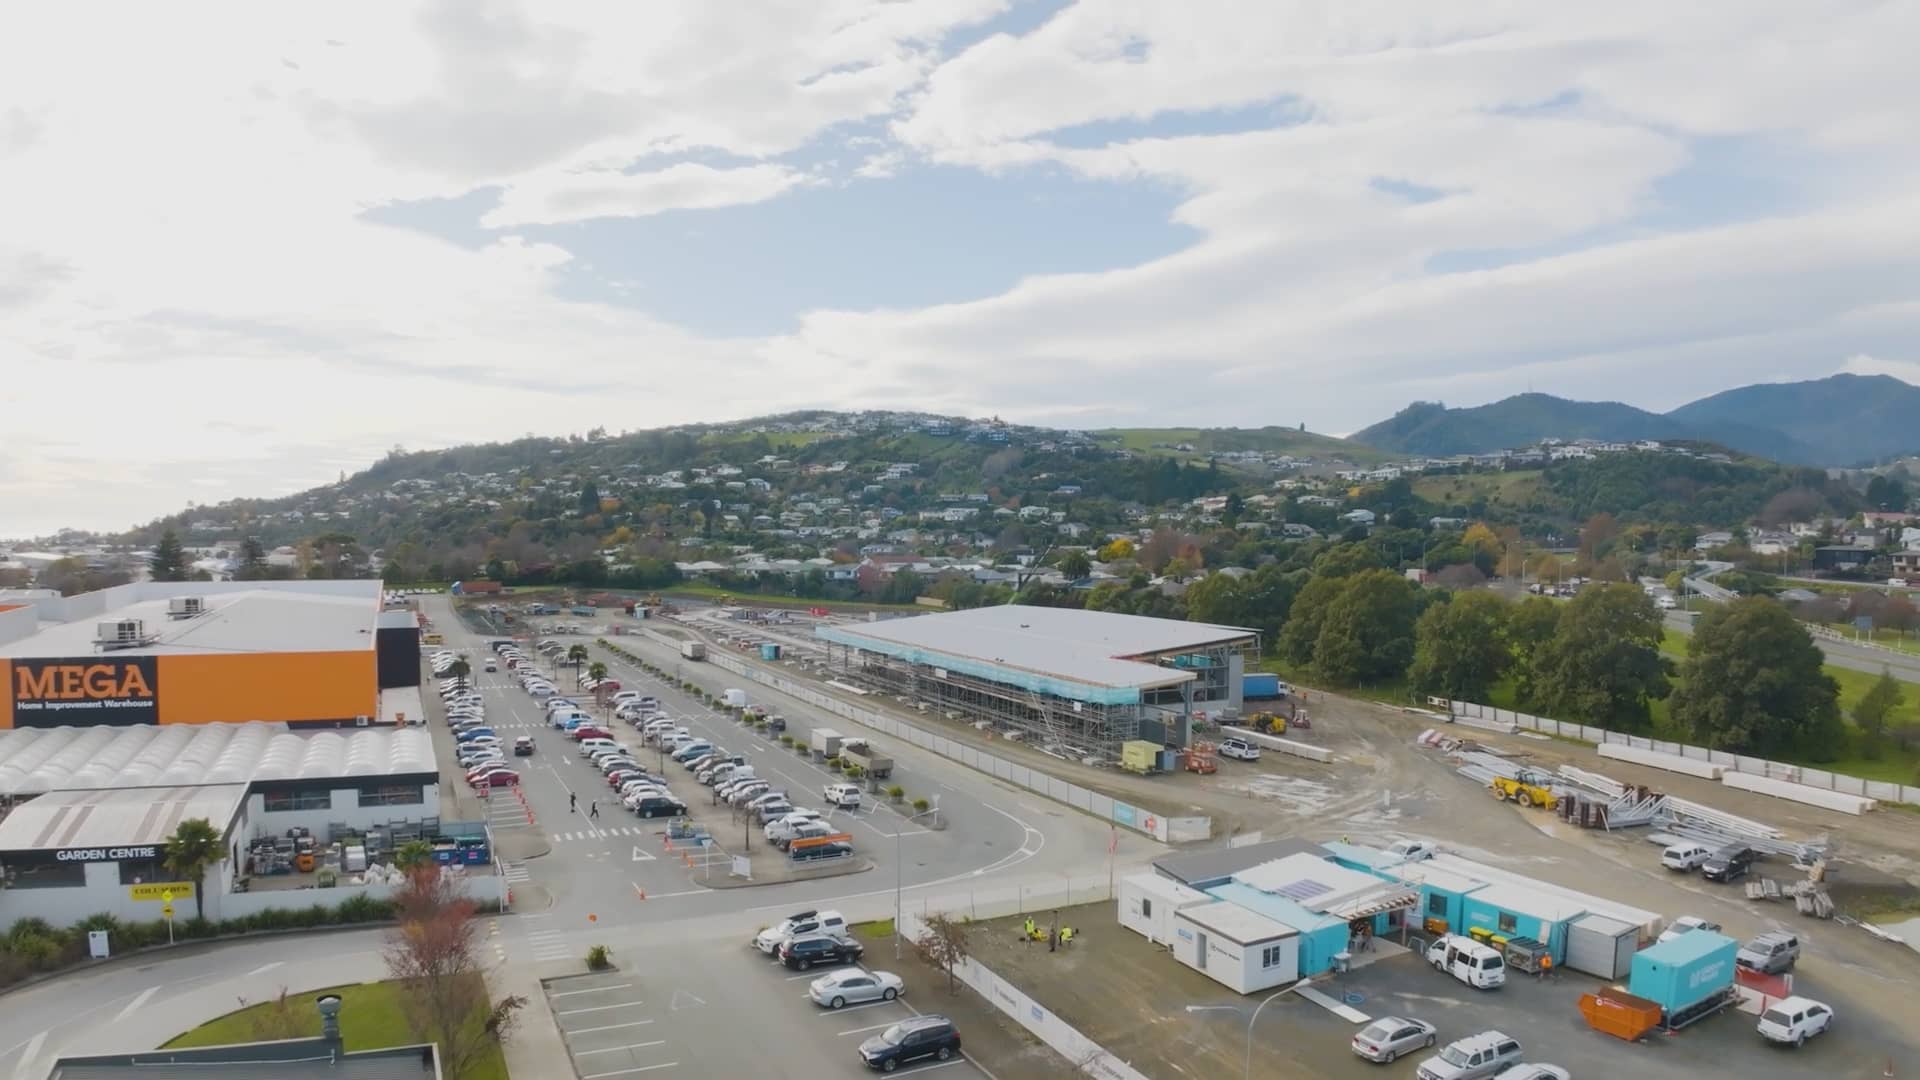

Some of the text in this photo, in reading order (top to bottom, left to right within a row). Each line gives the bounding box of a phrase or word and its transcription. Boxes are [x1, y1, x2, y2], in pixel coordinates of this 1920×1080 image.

[15, 664, 153, 699] MEGA
[17, 700, 153, 710] Home Improvement Warehouse
[56, 847, 156, 861] GARDEN CENTRE
